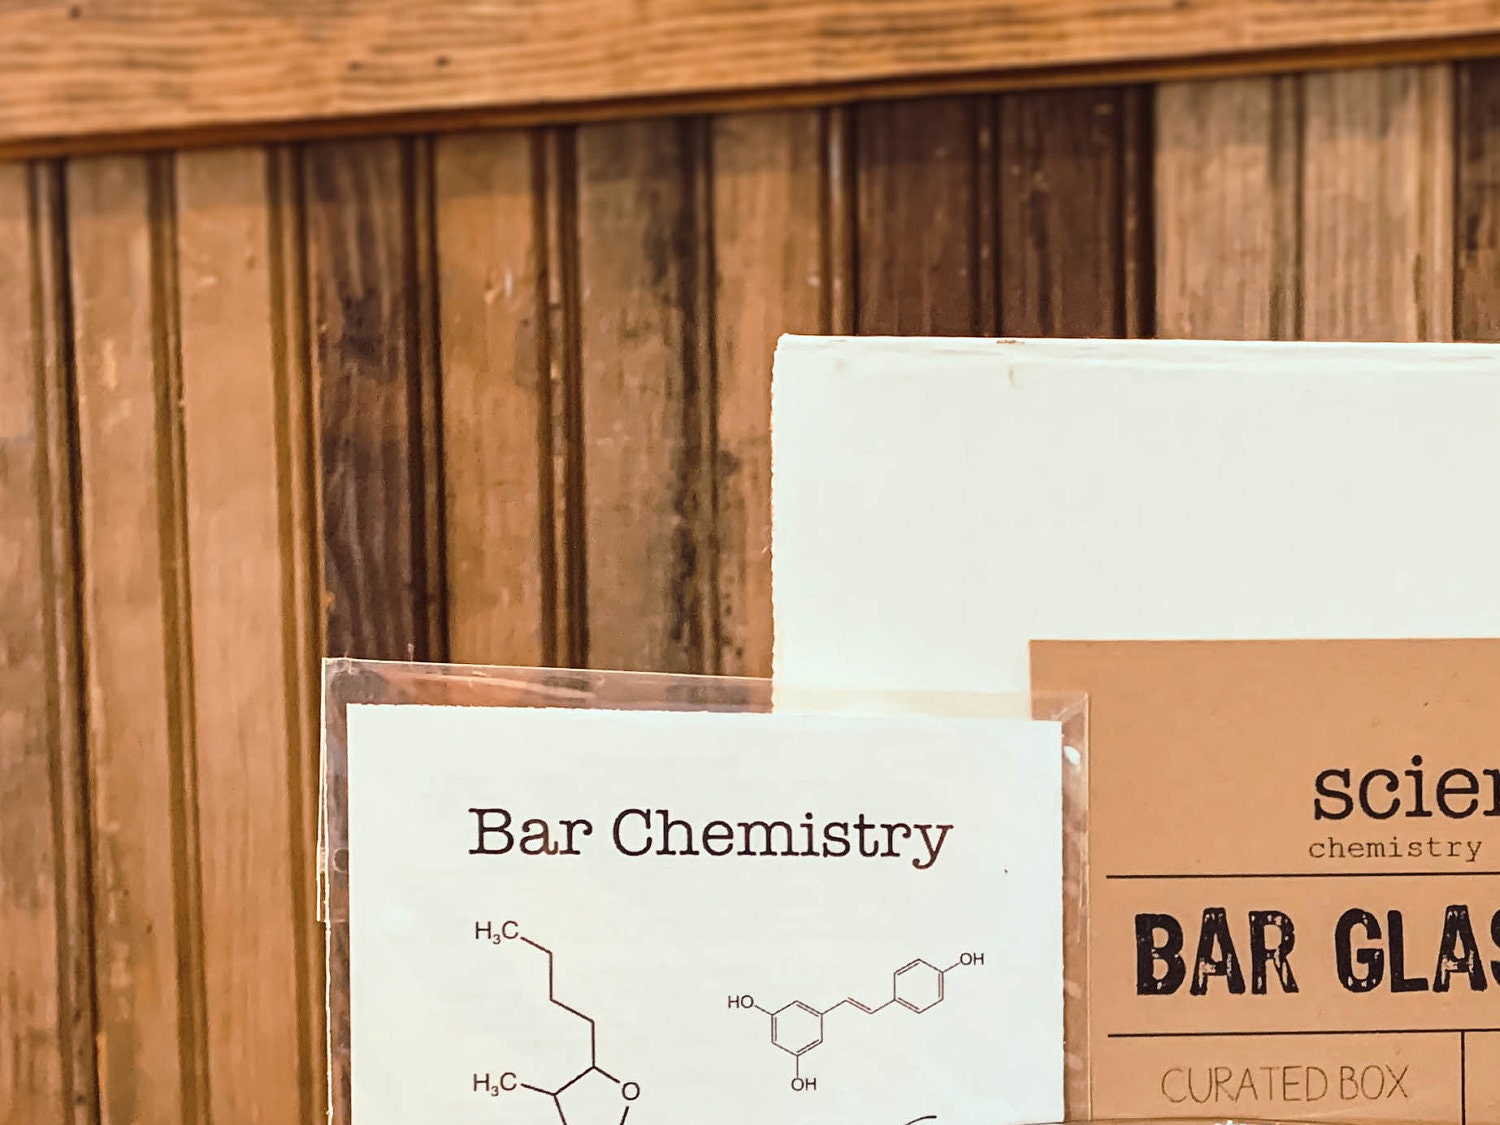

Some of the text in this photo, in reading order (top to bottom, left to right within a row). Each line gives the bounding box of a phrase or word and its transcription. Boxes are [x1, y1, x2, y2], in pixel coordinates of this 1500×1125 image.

[468, 808, 954, 869] Bar Chemistry
[1308, 835, 1482, 862] chemistry
[959, 952, 985, 967] OH
[1134, 907, 1300, 996] BAR
[727, 995, 755, 1011] HO
[791, 1076, 817, 1092] OH
[1161, 1064, 1409, 1104] CURATED BOX
